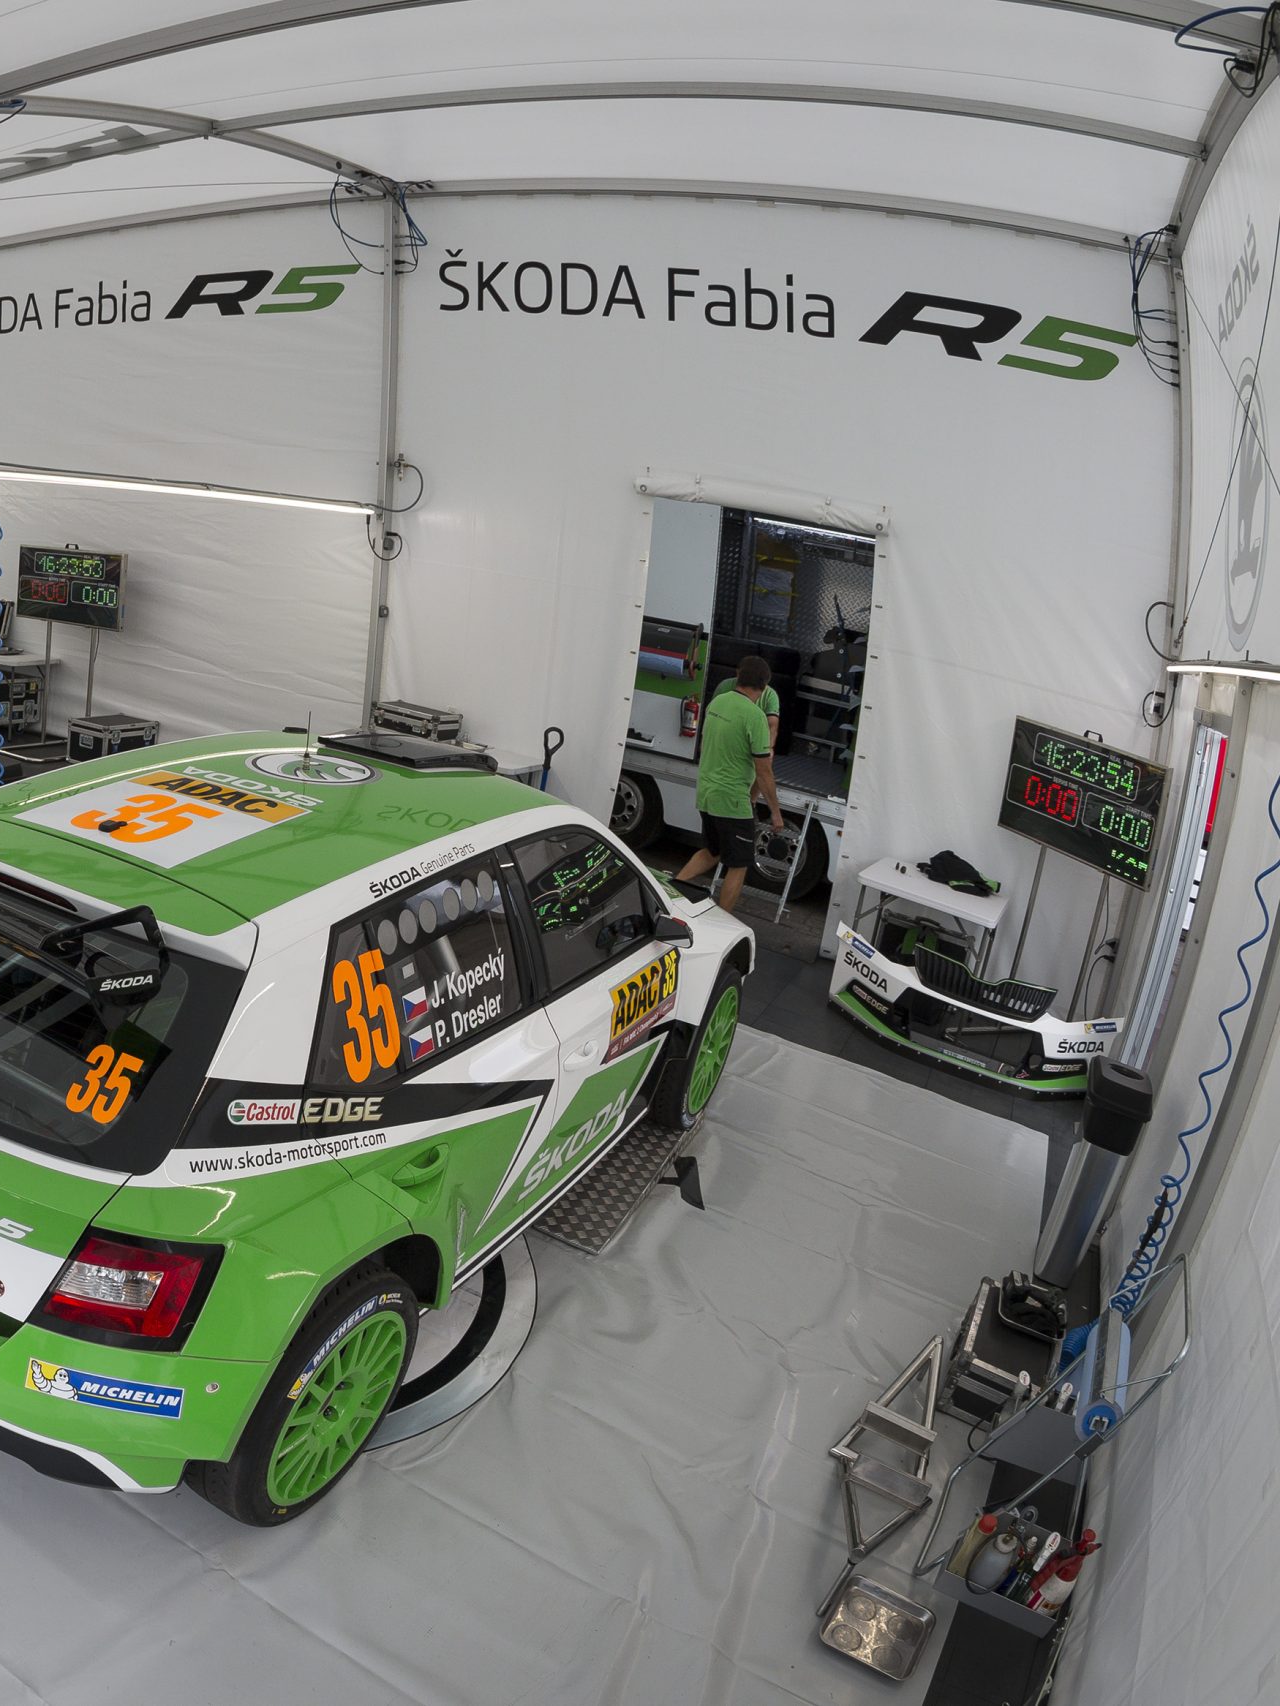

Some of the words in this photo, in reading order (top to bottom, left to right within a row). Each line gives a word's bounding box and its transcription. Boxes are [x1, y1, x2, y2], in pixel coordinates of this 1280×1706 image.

[54, 279, 151, 329] Fabia
[164, 263, 362, 320] R5
[437, 248, 646, 320] ŠKODA
[667, 267, 835, 339] Fabia
[858, 290, 1140, 381] R5
[39, 555, 103, 577] 16:23:53
[31, 579, 67, 602] 0:00
[82, 586, 117, 606] 0:00
[1041, 740, 1135, 797] 16:23:54
[70, 793, 225, 844] 35
[148, 776, 278, 815] ADAC
[1024, 775, 1079, 821] 0:00
[1099, 804, 1151, 848] 0:00
[368, 866, 423, 899] ŠKODA
[420, 851, 455, 875] Genuine
[452, 842, 476, 860] Parts
[99, 973, 154, 993] ŠKODA
[431, 980, 445, 1009] J.
[445, 947, 505, 1000] Kopecký
[613, 964, 660, 1037] ADAC
[662, 950, 678, 999] 35
[843, 950, 888, 993] ŠKODA
[332, 948, 401, 1084] 35
[434, 1019, 450, 1049] P.
[451, 993, 503, 1039] Dresler
[1056, 1038, 1105, 1054] ŠKODA
[65, 1043, 144, 1124] 35
[246, 1101, 297, 1122] Castrol
[299, 1096, 385, 1125] EDGE
[189, 1131, 387, 1175] www.skoda-motorsport.com
[517, 1088, 628, 1203] ŠKODA
[312, 1299, 376, 1368] MICHELIN
[79, 1380, 181, 1408] MICHELIN
